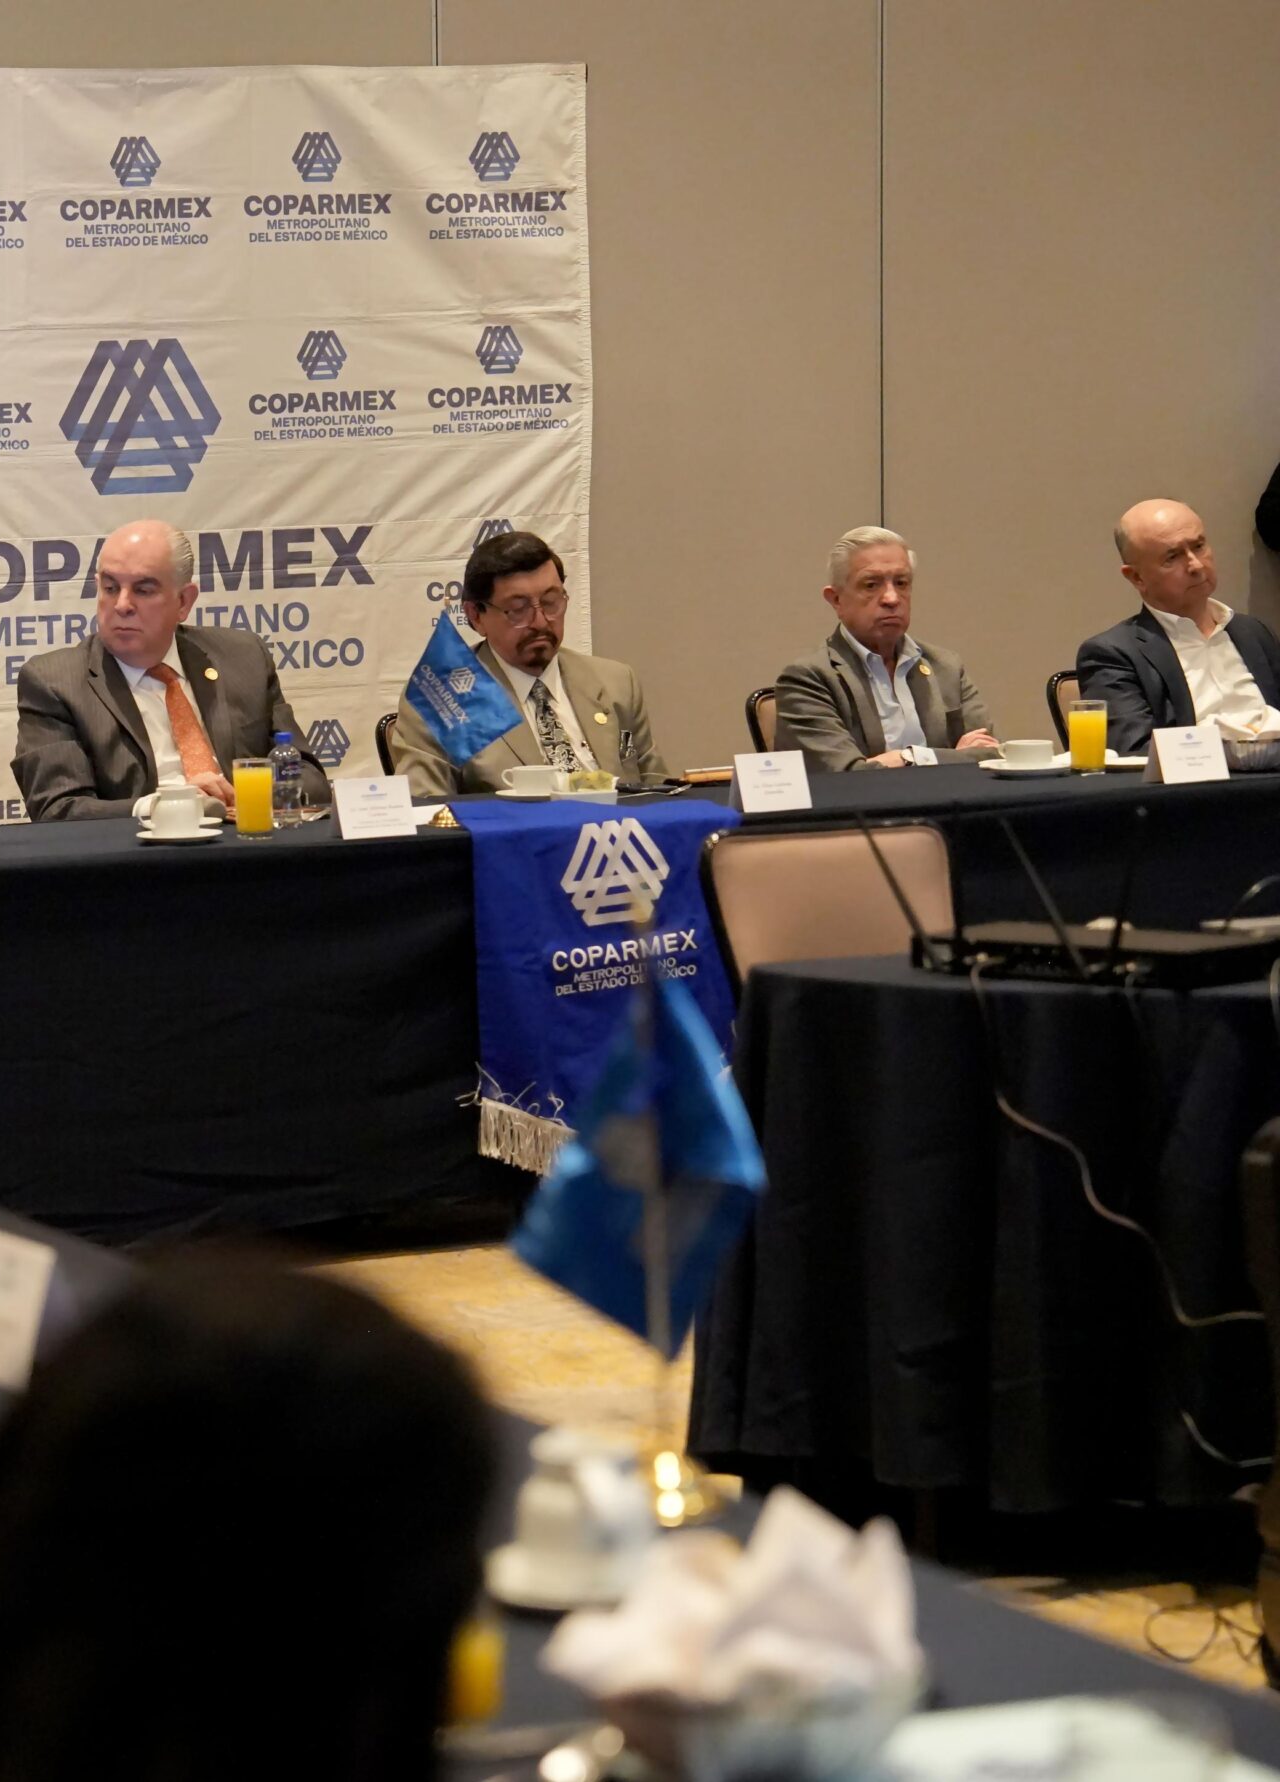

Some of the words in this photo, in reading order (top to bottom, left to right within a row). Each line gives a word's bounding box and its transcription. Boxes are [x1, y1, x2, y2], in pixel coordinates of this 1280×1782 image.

[60, 197, 212, 221] COPARMEX
[244, 194, 391, 216] COPARMEX
[425, 190, 567, 214] COPARMEX
[84, 222, 190, 235] METROPOLITANO
[266, 218, 370, 230] METROPOLITANO
[448, 215, 547, 227] METROPOLITANO
[65, 237, 91, 248] DEL
[94, 236, 140, 247] ESTADO
[142, 235, 158, 246] DE
[161, 234, 208, 245] MÉXICO
[249, 231, 272, 242] DEL
[275, 231, 322, 242] ESTADO
[324, 230, 340, 241] DE
[343, 229, 388, 240] MÉXICO
[429, 228, 452, 239] DEL
[456, 228, 501, 239] ESTADO
[504, 227, 518, 238] DE
[521, 226, 564, 237] MÉXICO
[248, 390, 397, 414] COPARMEX
[427, 383, 572, 408] COPARMEX
[271, 414, 375, 426] METROPOLITANO
[449, 408, 552, 420] METROPOLITANO
[254, 428, 277, 440] DEL
[280, 427, 327, 439] ESTADO
[329, 427, 344, 438] DE
[347, 425, 393, 437] MÉXICO
[432, 423, 455, 434] DEL
[458, 422, 504, 433] ESTADO
[506, 421, 521, 432] DE
[523, 419, 569, 431] MÉXICO
[265, 635, 364, 670] XICO
[421, 664, 469, 724] COPARMEX
[552, 928, 697, 972] COPARMEX
[574, 957, 676, 983] METROPOLITNO
[555, 984, 577, 996] DEL
[579, 977, 627, 993] ESTADO
[666, 964, 697, 978] XICO
